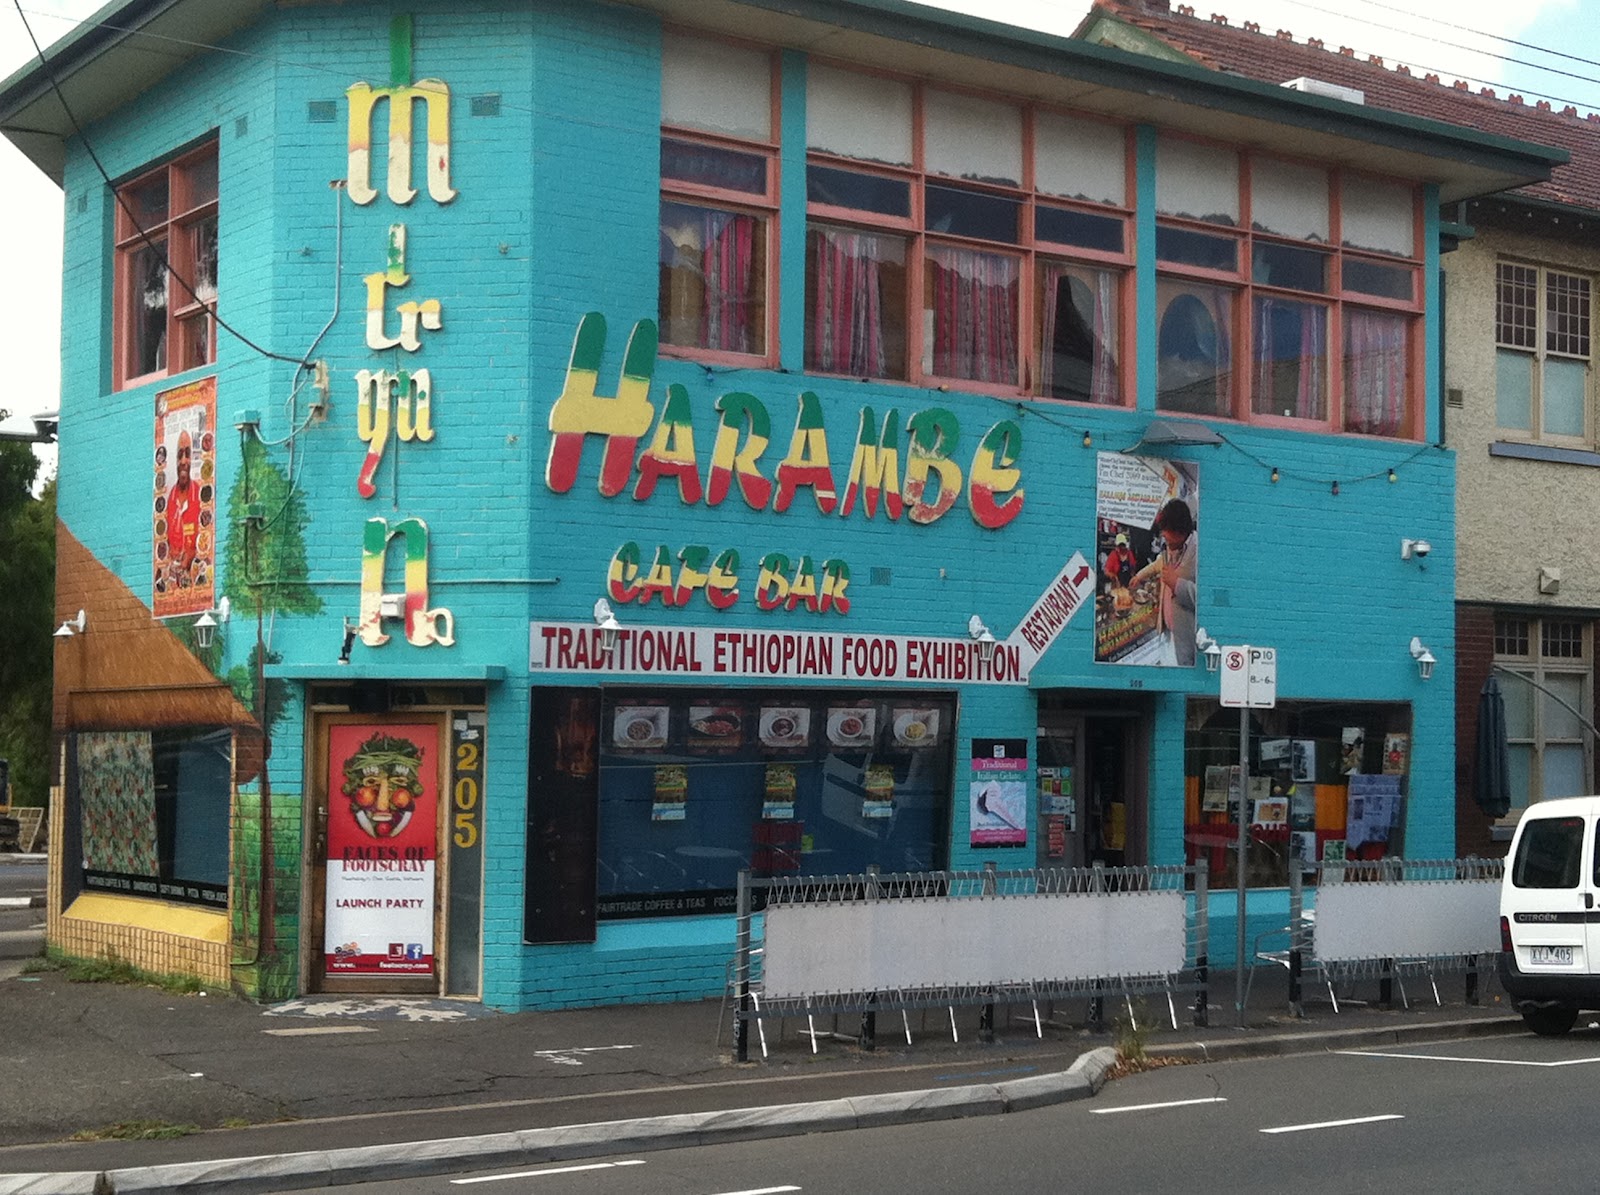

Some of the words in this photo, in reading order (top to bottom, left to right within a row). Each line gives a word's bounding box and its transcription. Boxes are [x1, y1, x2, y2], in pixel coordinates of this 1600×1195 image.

[607, 541, 740, 610] CAFE
[756, 552, 850, 615] BAR
[1020, 574, 1081, 655] RESTAURANT
[714, 632, 833, 676] ETHIOPIAN
[842, 636, 898, 678] FOOD
[906, 640, 1020, 683] EXHIBITION
[1251, 650, 1261, 664] P
[1263, 650, 1273, 660] 10
[982, 760, 1018, 769] Traditional
[343, 846, 400, 860] FACES
[405, 846, 427, 860] OF
[342, 860, 427, 872] FOOTSCRAY
[336, 899, 382, 908] LAUNCH
[386, 899, 424, 908] PARTY
[598, 900, 642, 914] FAIRTRADE
[644, 899, 675, 911] COFFEE
[677, 898, 684, 909] &
[686, 897, 706, 909] TEAS
[1554, 949, 1571, 961] 405
